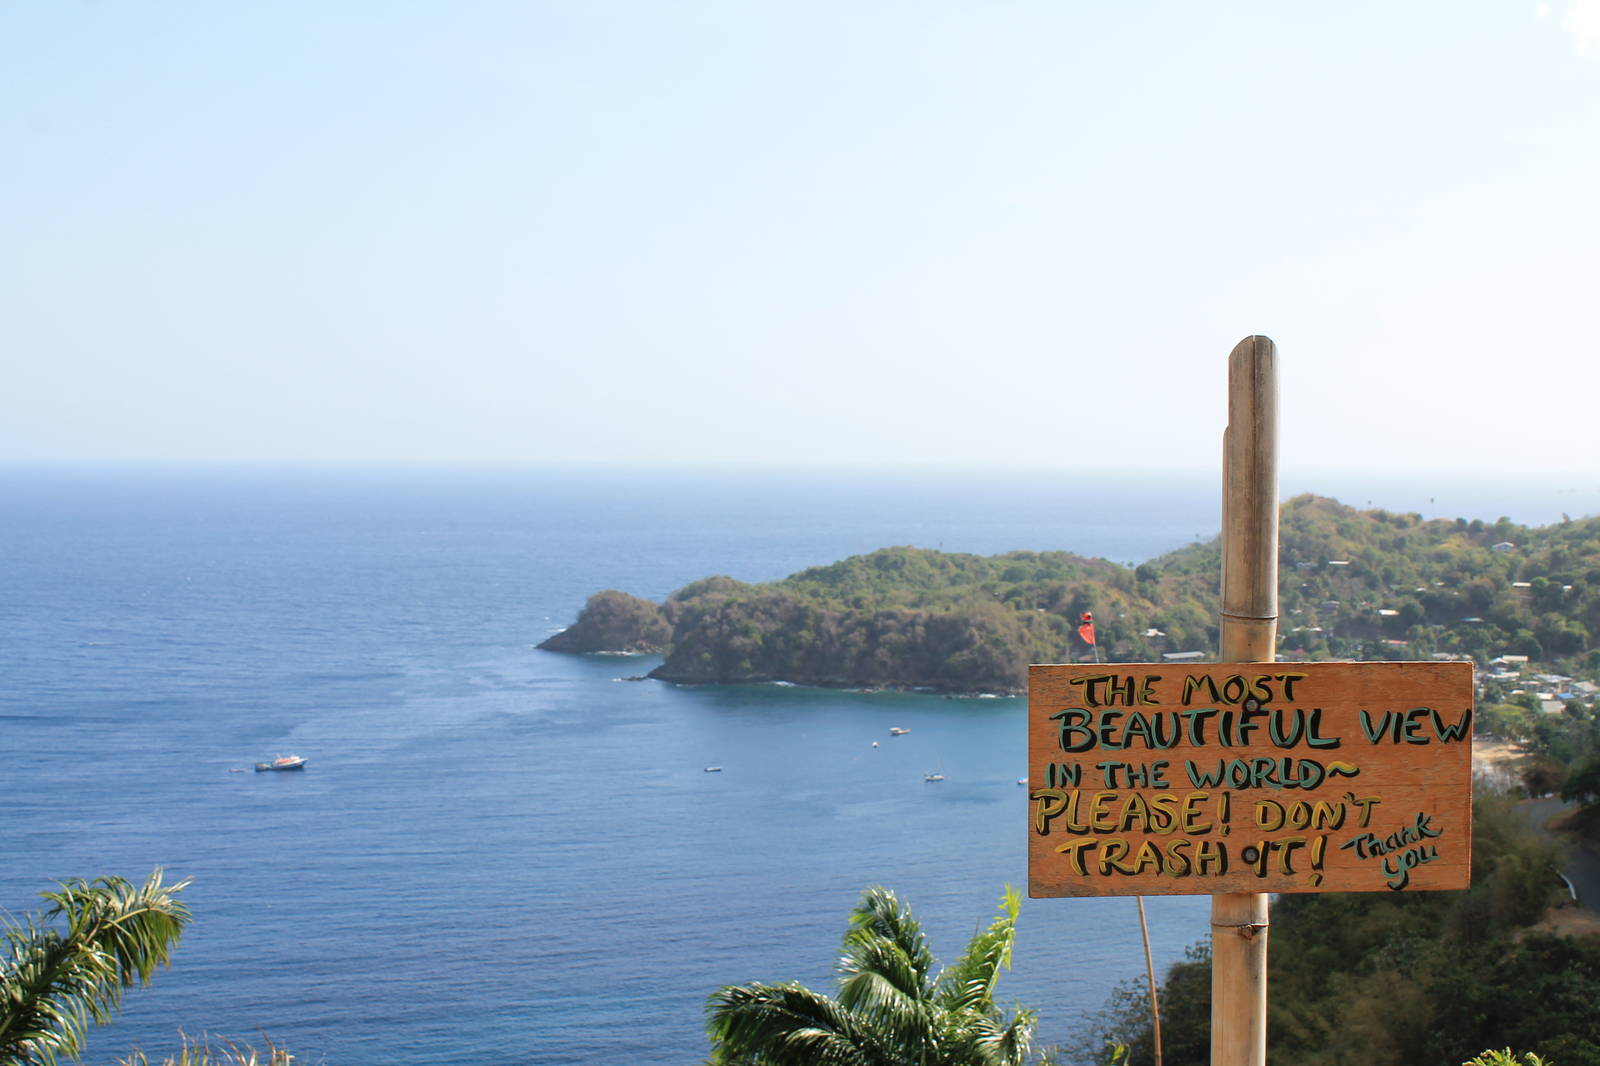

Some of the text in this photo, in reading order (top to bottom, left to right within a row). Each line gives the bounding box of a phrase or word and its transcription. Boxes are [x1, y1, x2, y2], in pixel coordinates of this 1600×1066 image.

[1069, 672, 1309, 707] THE MOST
[1049, 706, 1473, 752] BEAUTIFUL VIEW
[1044, 762, 1082, 789] IN
[1095, 760, 1170, 789] THE
[1030, 788, 1382, 837] PLEASE! DON'T
[1054, 834, 1328, 888] TRASH IT!
[1381, 844, 1441, 891] you
